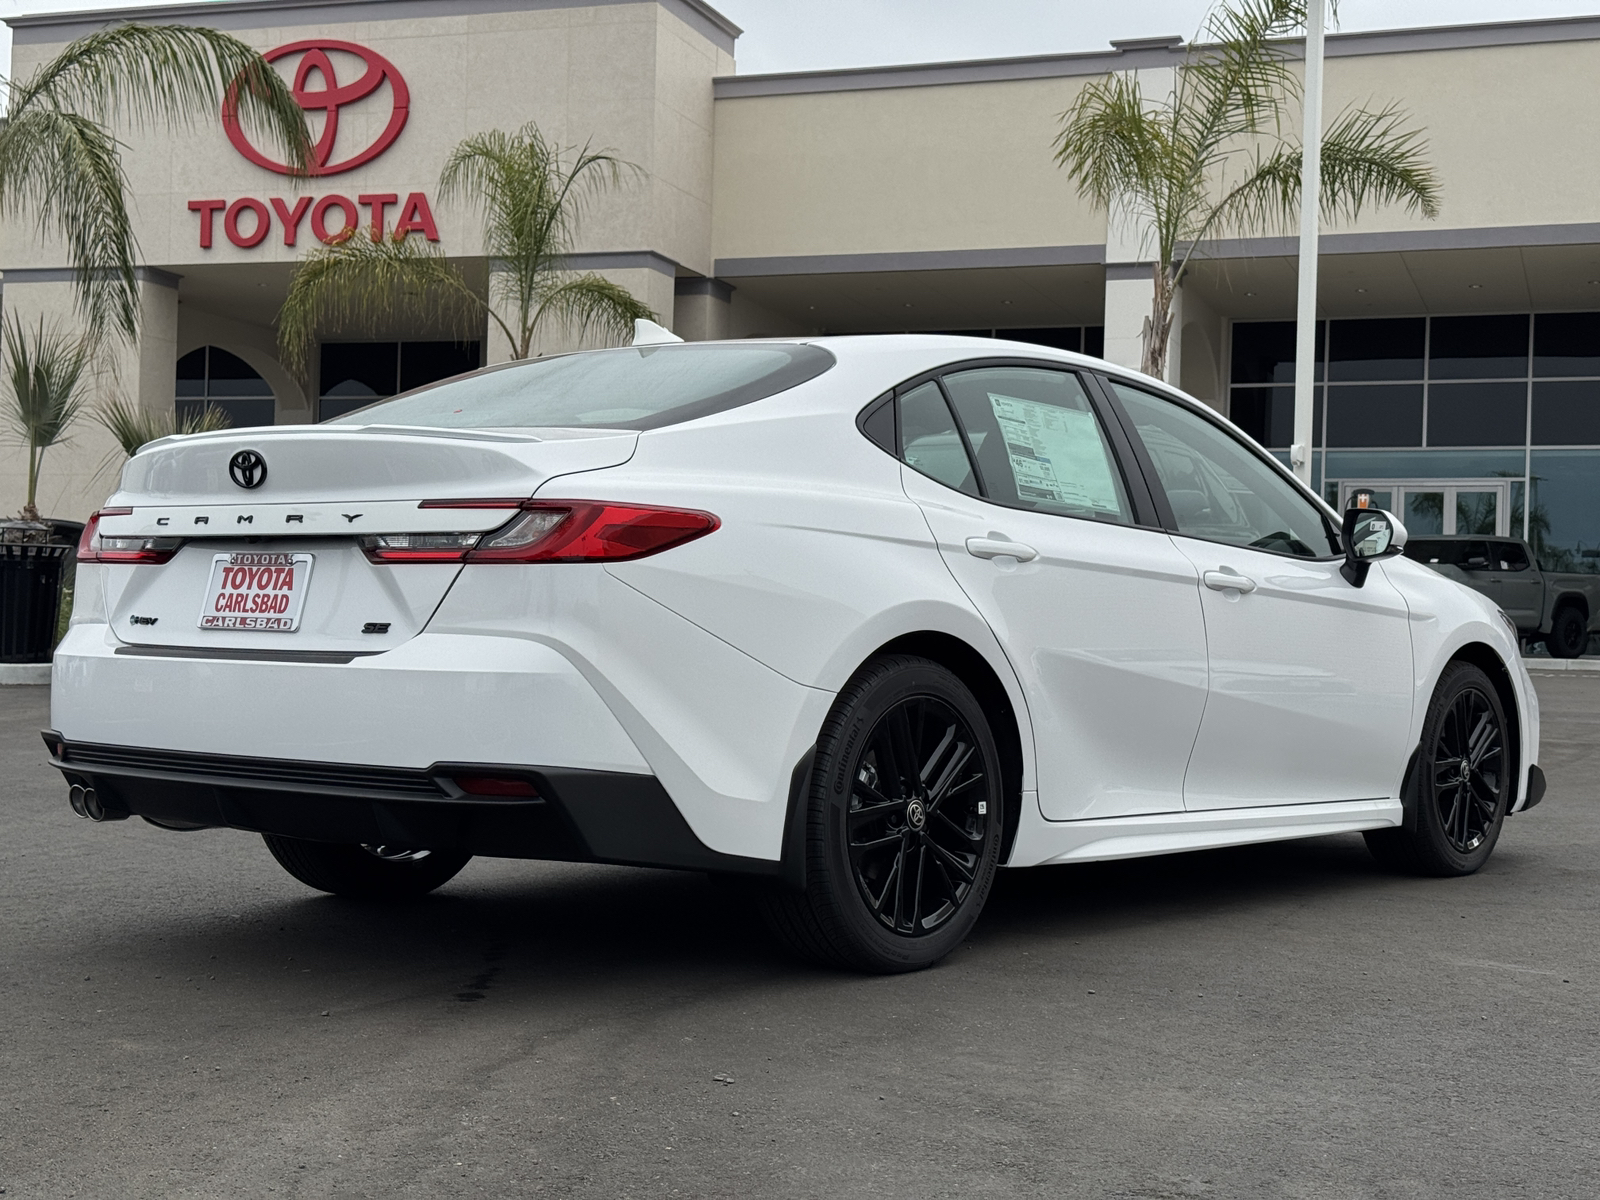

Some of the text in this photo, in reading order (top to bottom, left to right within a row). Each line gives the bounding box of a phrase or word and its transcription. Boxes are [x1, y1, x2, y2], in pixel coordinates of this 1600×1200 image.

[188, 192, 440, 249] TOYOTA
[156, 513, 363, 526] CAMRY
[237, 555, 286, 564] TOYOTA
[221, 567, 294, 591] TOYOTA
[215, 592, 290, 614] CARLSBAD
[201, 616, 293, 629] CARLSBAD
[361, 622, 391, 634] SE
[1427, 707, 1442, 757] Continental
[834, 723, 861, 795] Continental
